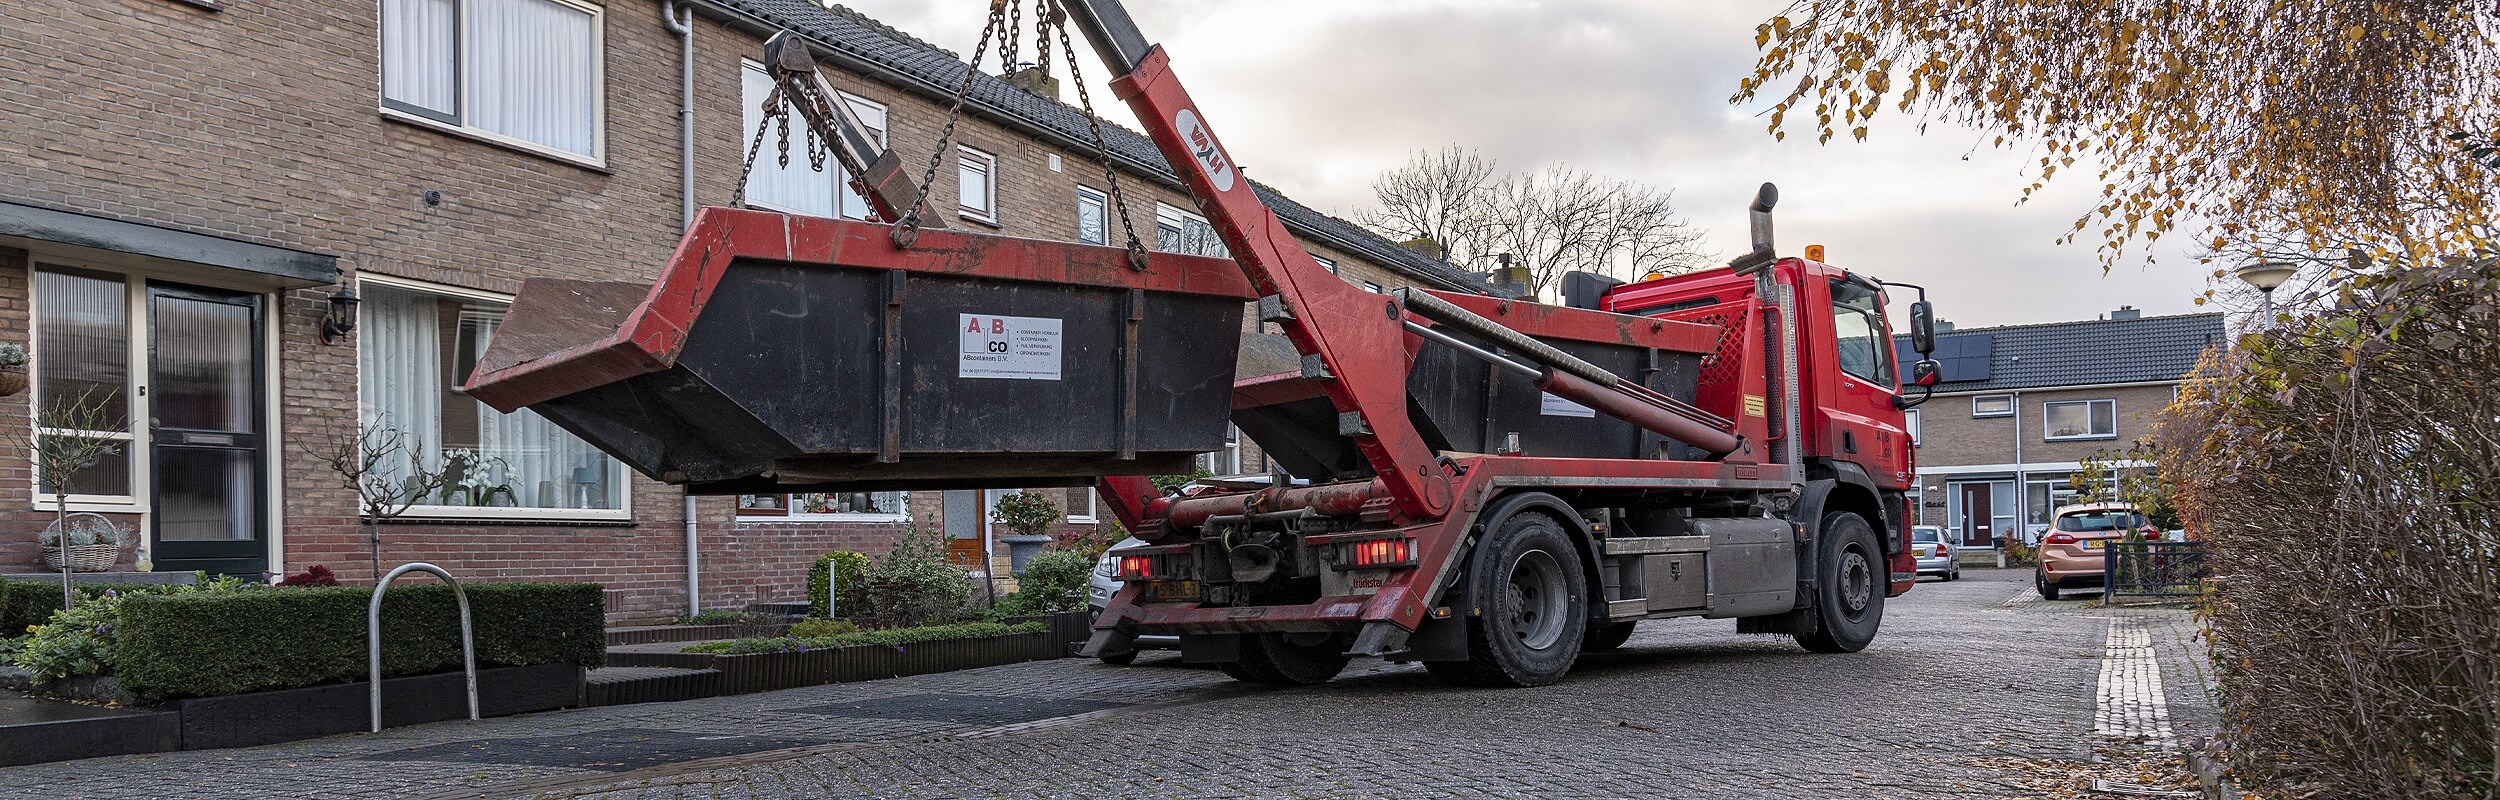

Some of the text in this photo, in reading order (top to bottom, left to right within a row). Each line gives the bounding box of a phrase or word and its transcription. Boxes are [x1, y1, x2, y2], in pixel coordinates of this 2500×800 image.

[1190, 123, 1225, 175] HYVA
[968, 317, 1004, 334] A B
[988, 341, 1008, 353] CO
